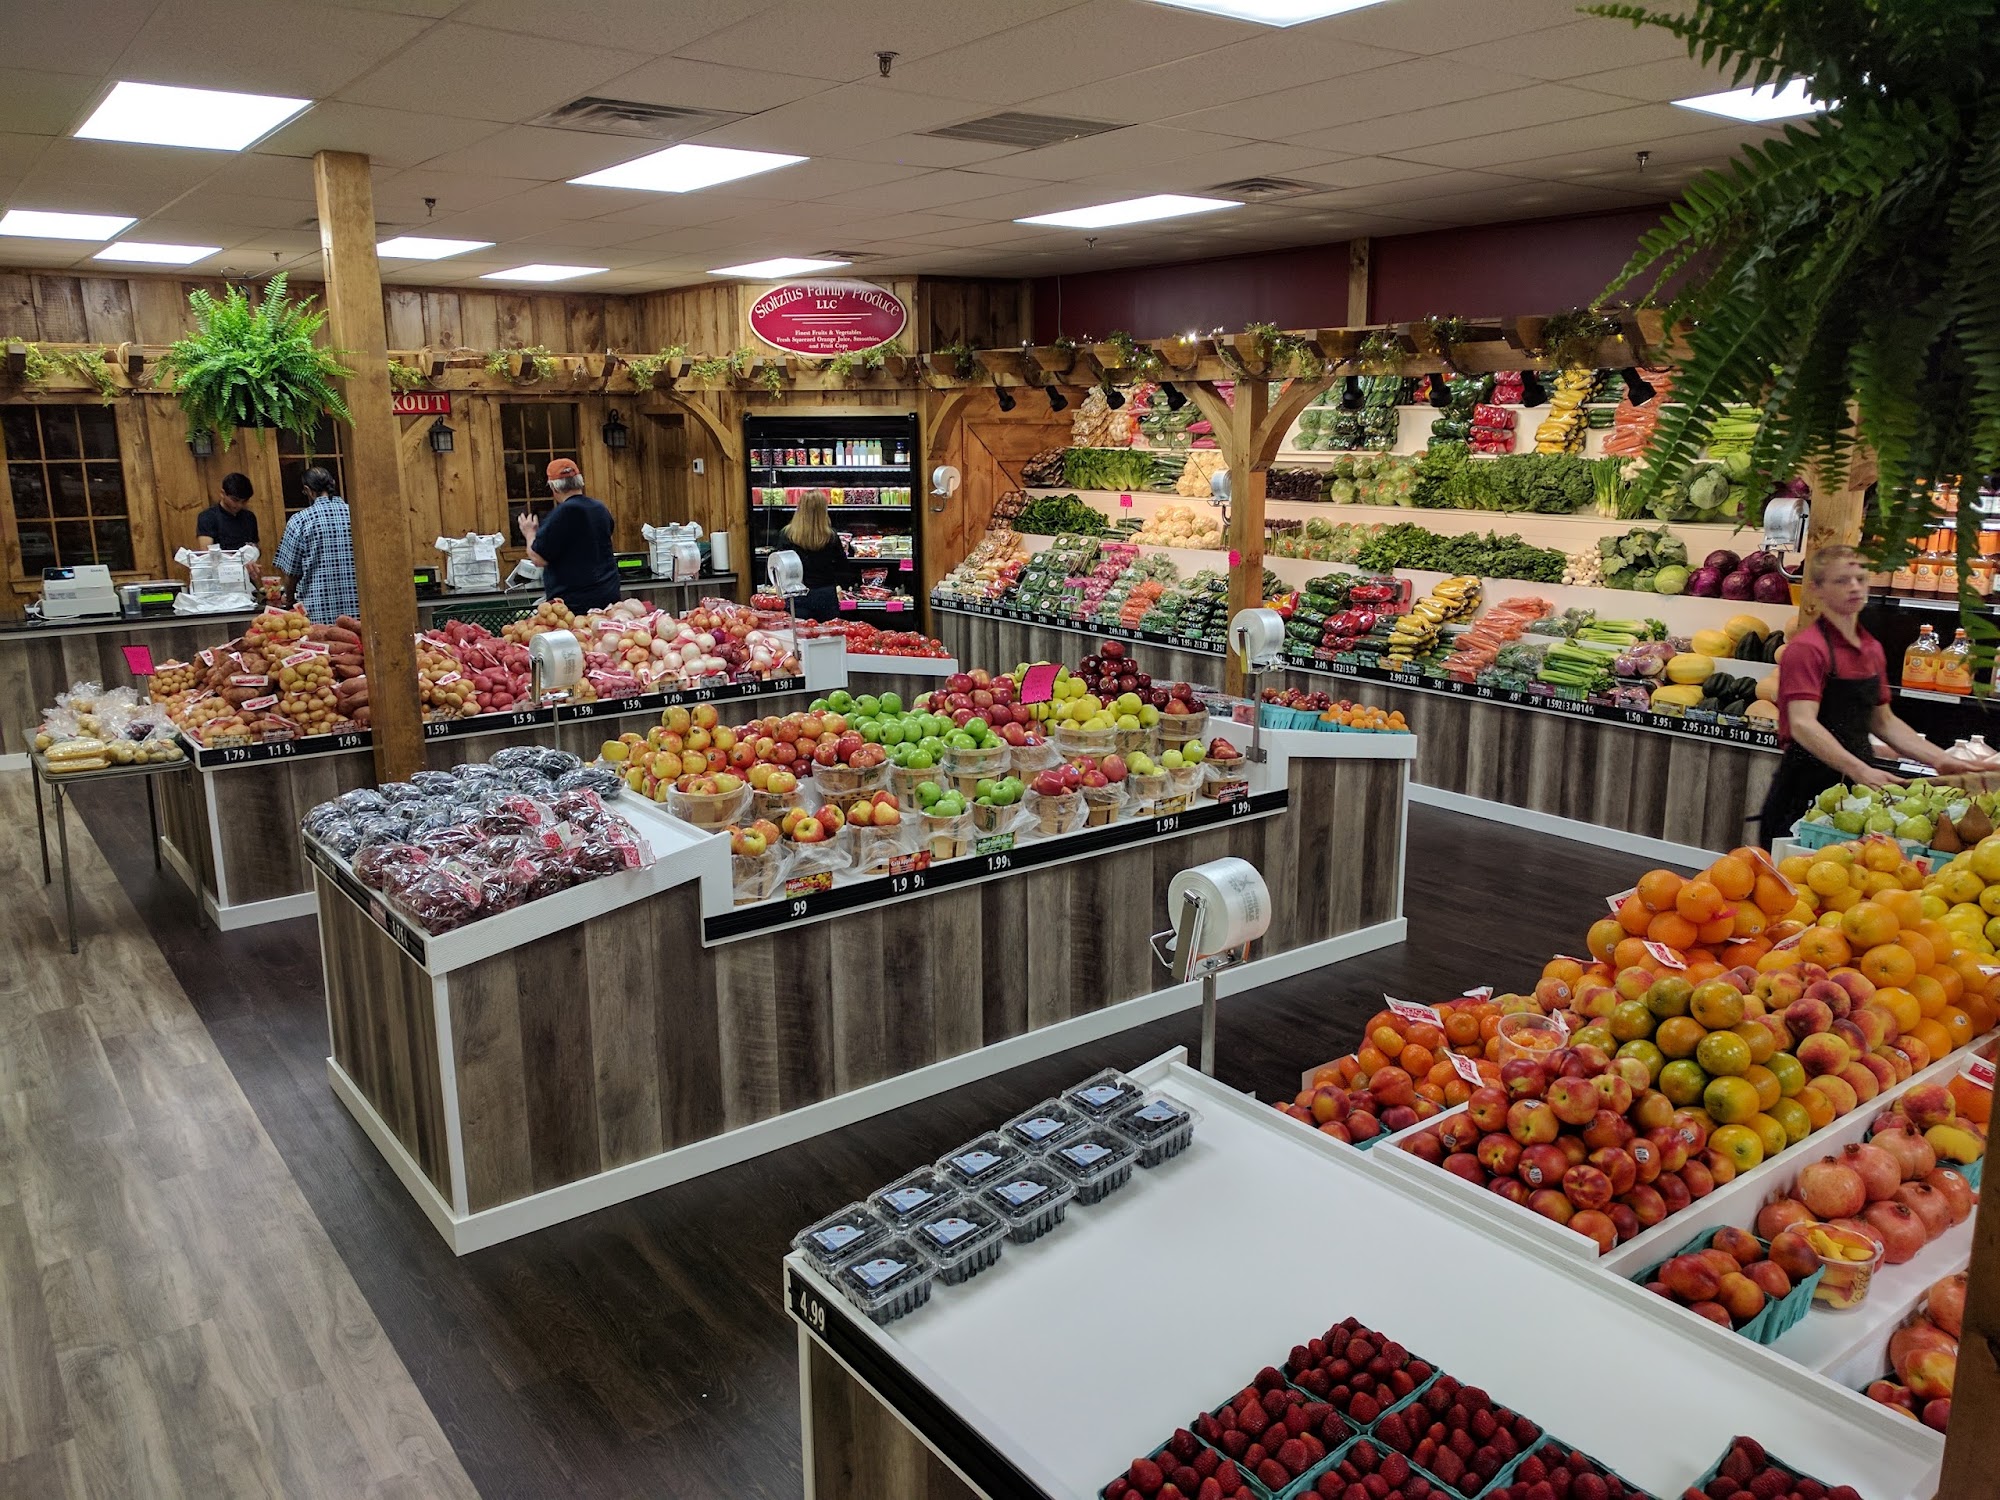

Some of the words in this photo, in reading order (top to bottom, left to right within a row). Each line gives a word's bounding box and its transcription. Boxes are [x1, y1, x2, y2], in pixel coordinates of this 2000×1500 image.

[754, 287, 804, 319] Stoltzfus
[807, 284, 847, 299] Family
[851, 287, 899, 317] Produce
[816, 300, 838, 309] LLC
[392, 395, 445, 410] KOUT
[742, 684, 756, 694] 1.29
[774, 681, 788, 690] 1.50
[696, 690, 710, 700] 1.29
[1477, 687, 1490, 697] 2.99
[622, 700, 639, 710] 1.59
[664, 695, 681, 704] 1.49
[573, 705, 591, 716] 1.59
[1626, 712, 1641, 722] 1.50
[1653, 716, 1668, 727] 3.95
[427, 724, 445, 735] 1.59
[1682, 721, 1698, 732] 2.95
[1703, 725, 1720, 736] 2.19
[338, 735, 357, 747] 1.49
[1756, 733, 1774, 745] 2.50
[224, 749, 245, 761] 1.79
[1232, 801, 1248, 815] 1.99
[1156, 818, 1174, 832] 1.99
[901, 857, 915, 866] Apples
[988, 855, 1008, 870] 1.99
[788, 881, 803, 891] Apples
[791, 901, 807, 916] .99
[800, 1291, 825, 1331] 4.99
